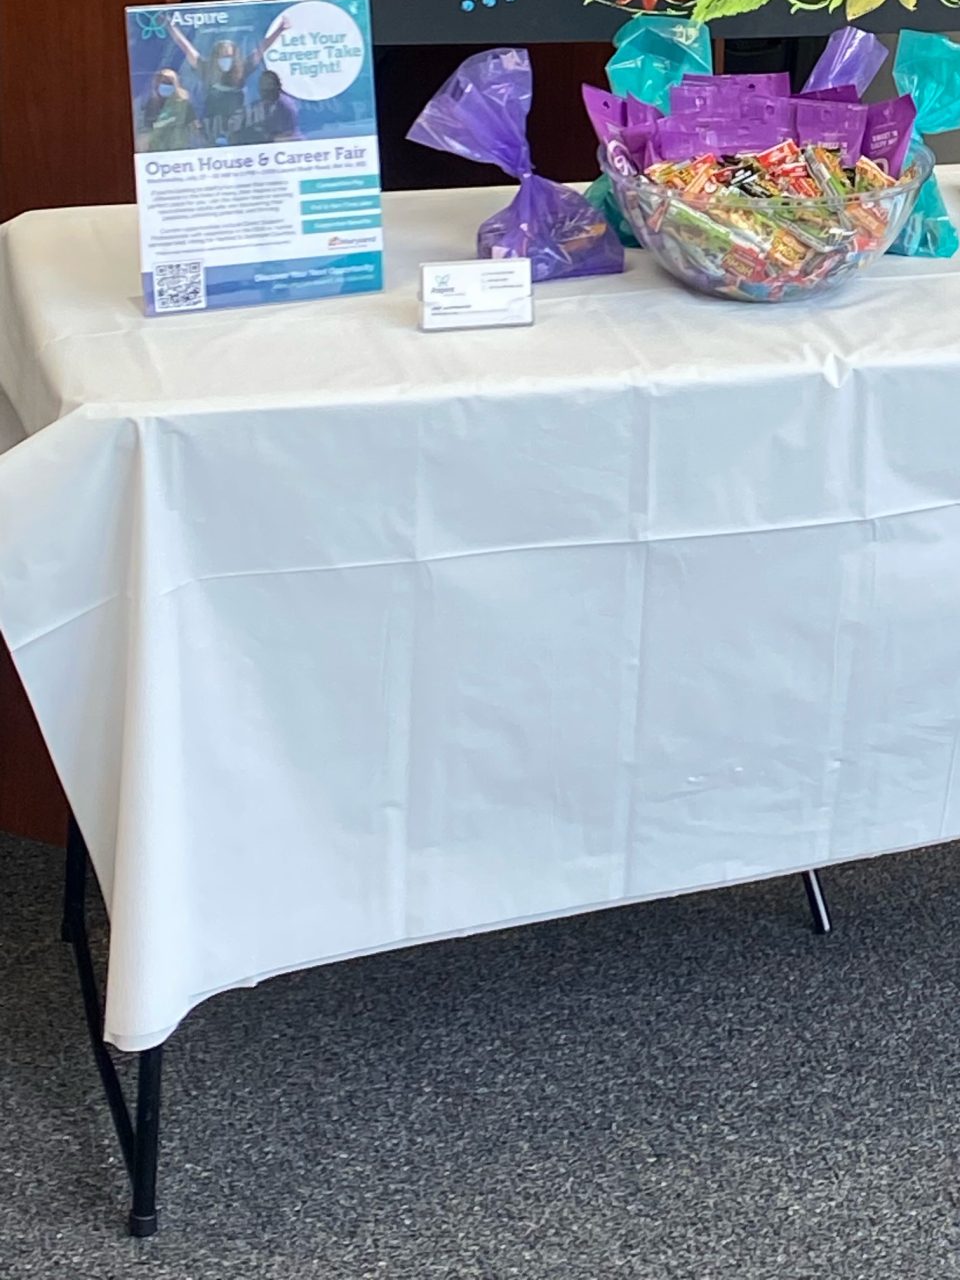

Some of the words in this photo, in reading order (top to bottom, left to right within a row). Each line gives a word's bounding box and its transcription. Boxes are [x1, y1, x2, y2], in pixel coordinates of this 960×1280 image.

[170, 11, 230, 29] Aspire
[281, 33, 307, 47] Let
[308, 31, 347, 45] Your
[266, 49, 321, 62] Career
[323, 45, 362, 58] Take
[289, 60, 342, 77] Flight!
[145, 161, 194, 177] Open
[197, 157, 254, 171] House
[258, 152, 270, 166] &
[274, 151, 331, 165] Career
[335, 146, 367, 160] Fair
